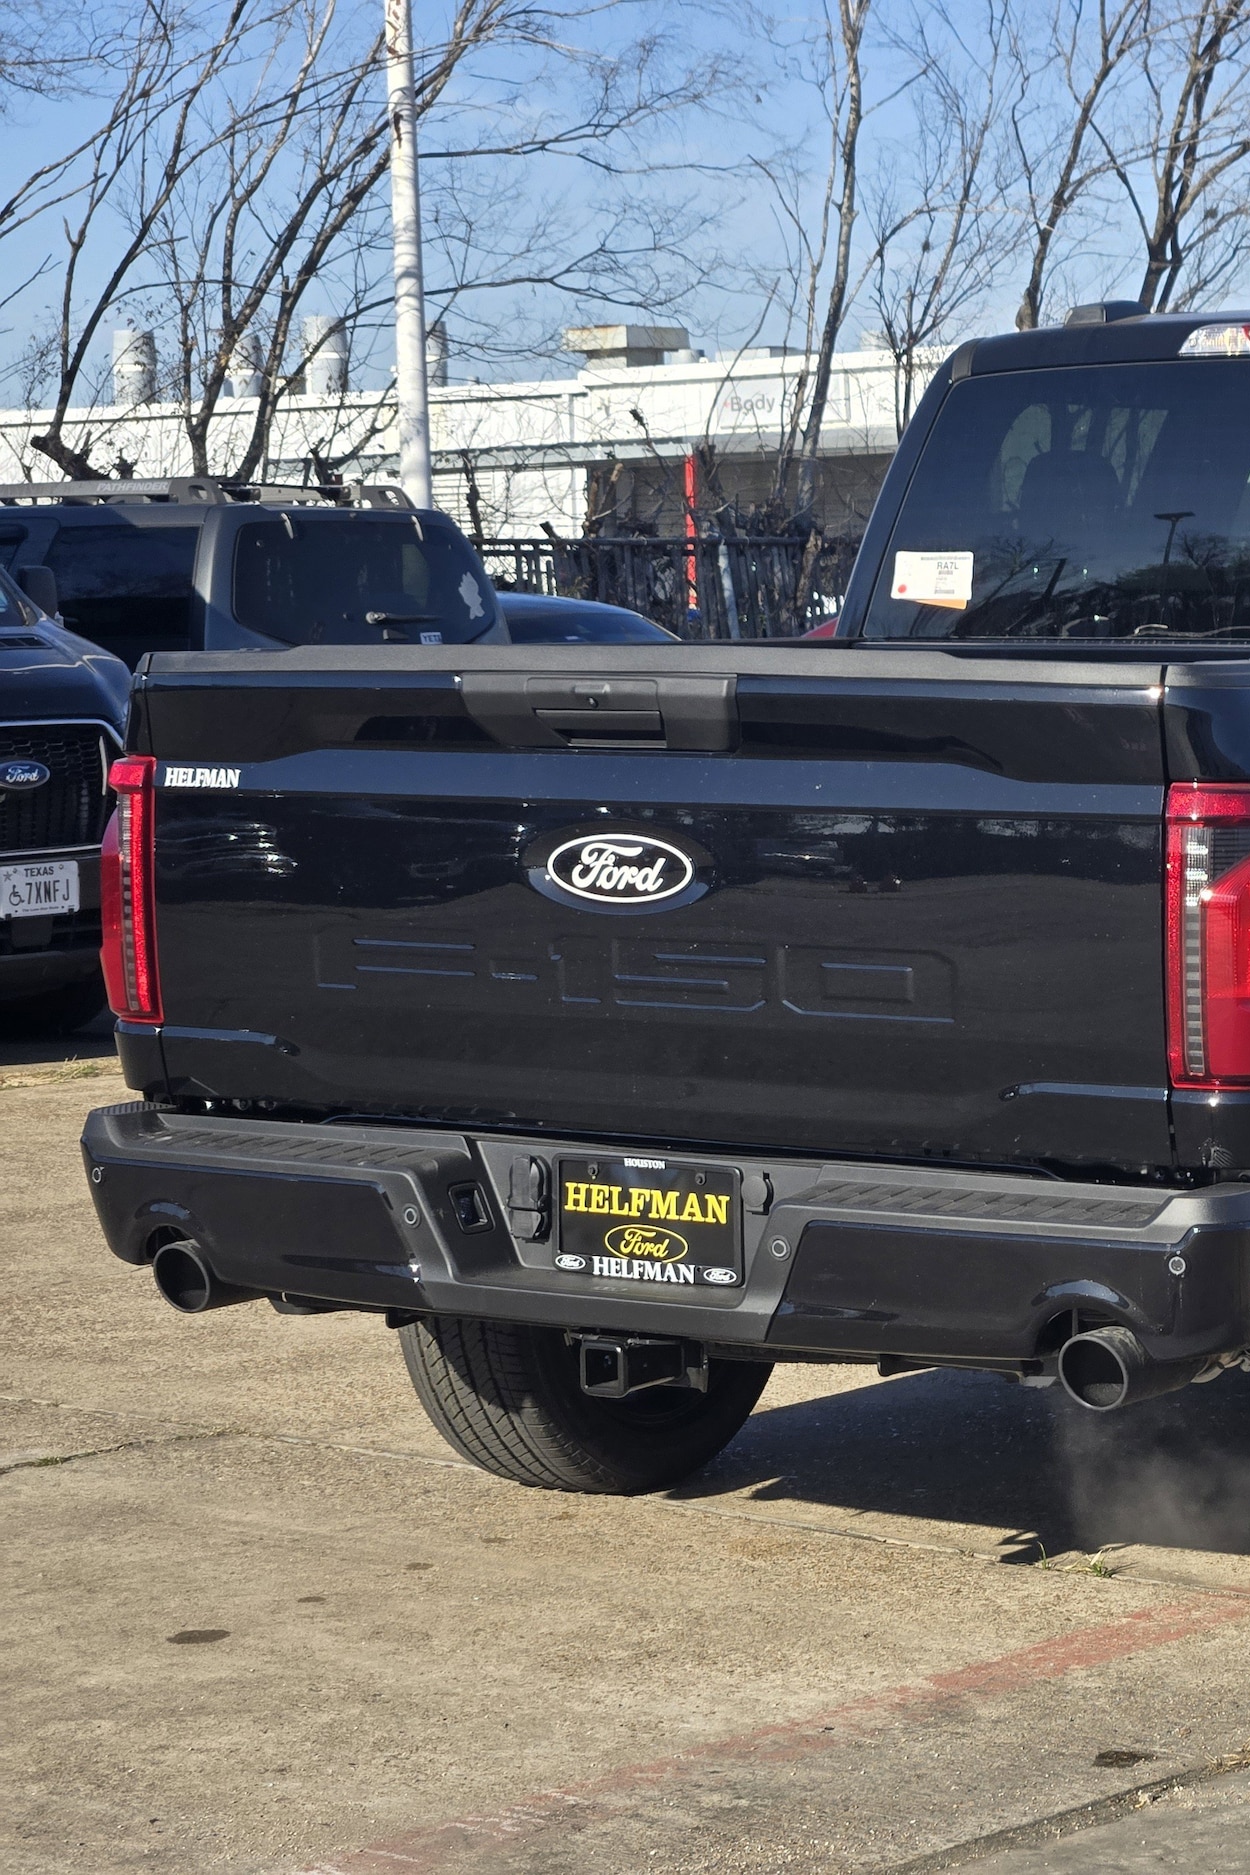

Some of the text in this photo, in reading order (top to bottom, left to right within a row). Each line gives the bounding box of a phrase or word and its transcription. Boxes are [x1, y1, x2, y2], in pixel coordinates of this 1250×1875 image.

[730, 393, 776, 413] Body
[96, 481, 169, 492] PATHFINDER
[936, 562, 959, 570] RA7L
[5, 764, 39, 783] Ford
[163, 766, 241, 789] HELFMAN
[24, 866, 55, 877] TEXAS
[571, 841, 664, 893] Ford
[26, 878, 70, 905] 7XNFJ
[313, 923, 958, 1022] F-150
[623, 1157, 666, 1170] HOUSTON
[564, 1181, 730, 1225] HELFMAN
[619, 1227, 670, 1259] Ford
[592, 1255, 696, 1284] HELFMAN
